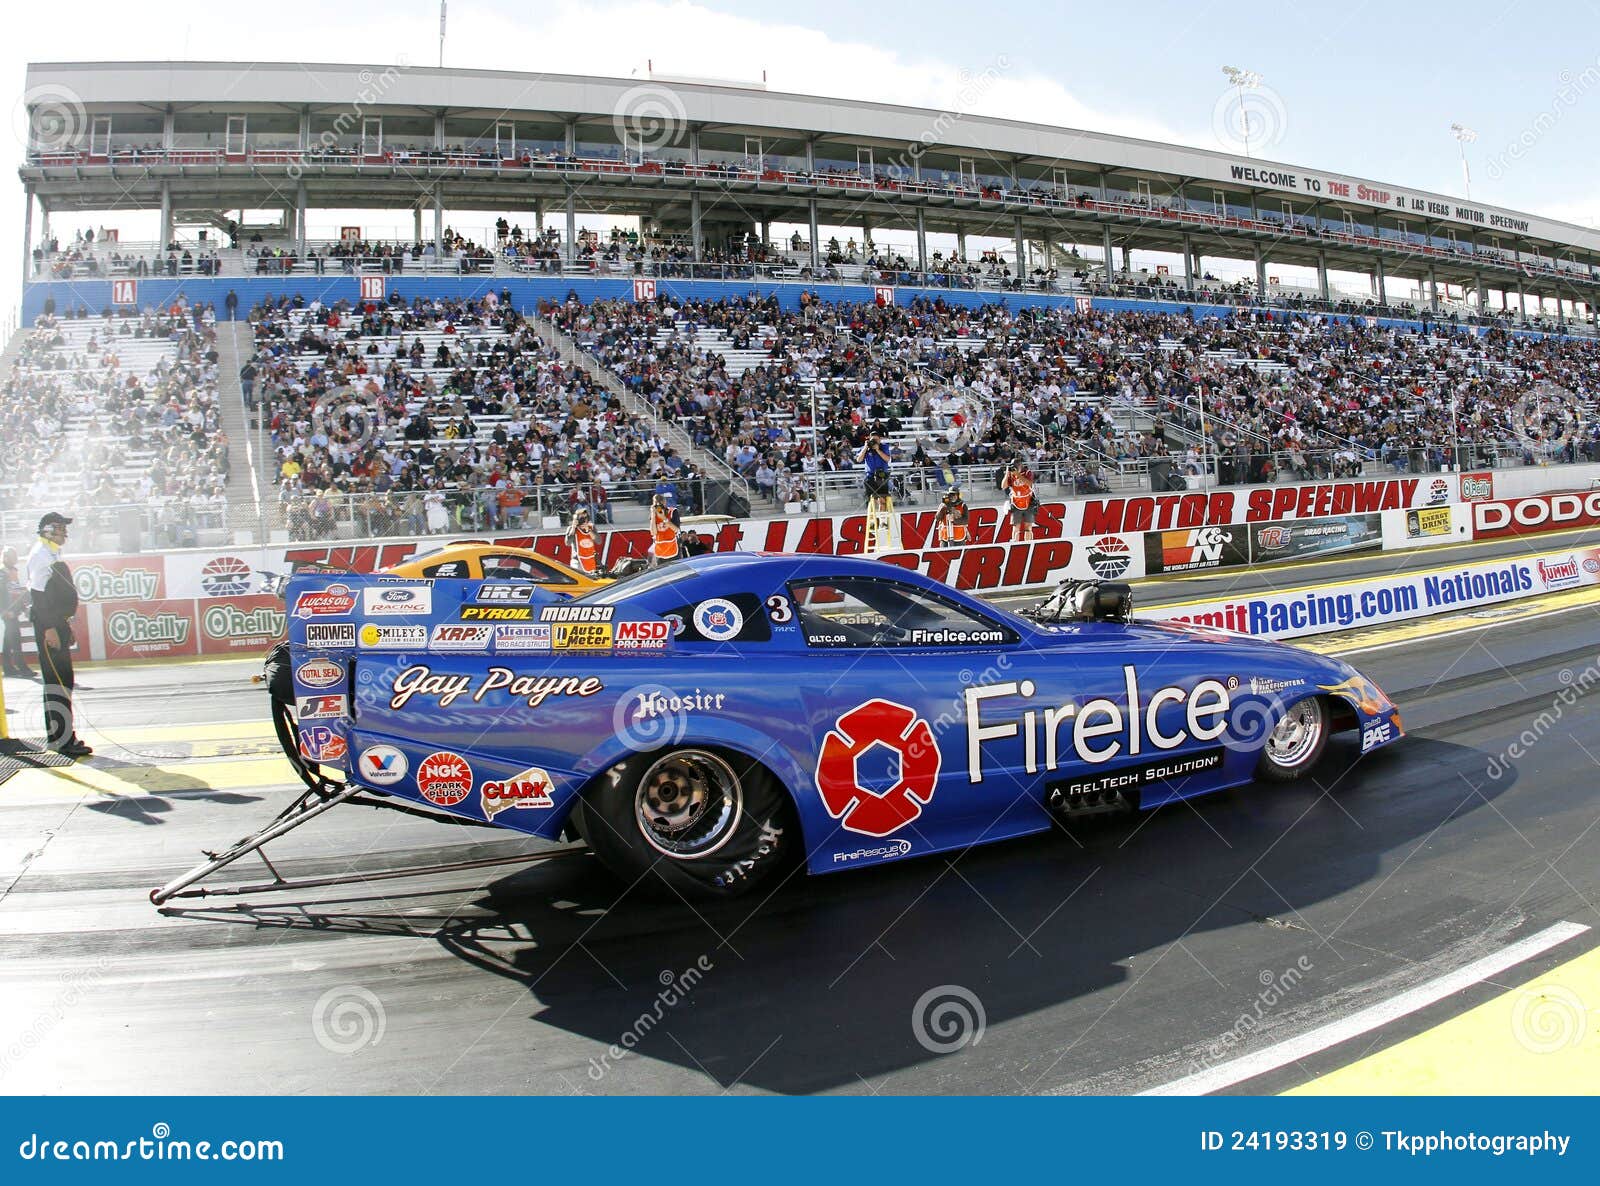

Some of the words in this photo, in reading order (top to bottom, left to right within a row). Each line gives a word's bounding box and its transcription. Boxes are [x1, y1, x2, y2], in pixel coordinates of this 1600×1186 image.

[1230, 165, 1297, 188] WELCOME
[1303, 177, 1321, 192] TO
[1327, 180, 1350, 198] THE
[1357, 183, 1391, 204] STRIP
[1411, 198, 1425, 213] LAS
[1428, 201, 1450, 217] VEGAS
[1455, 207, 1485, 224] MOTOR
[1489, 214, 1530, 233] SPEEDWAY
[114, 282, 135, 302] 1A
[363, 278, 384, 299] 1B
[635, 280, 655, 300] 1C
[1463, 478, 1490, 497] O'Reilly
[763, 514, 875, 554] LAS
[900, 502, 1067, 550] VGAS
[1080, 491, 1235, 537] MOTOR
[1246, 479, 1420, 522] SPEEDWAY
[1422, 519, 1449, 529] DRINK
[1258, 528, 1292, 547] TRE
[1304, 527, 1323, 536] DRAG
[1322, 525, 1347, 535] RACING
[438, 563, 458, 573] 2
[74, 567, 158, 600] O'Reilly
[1424, 563, 1533, 607] Nationals
[302, 596, 334, 607] LUCAS
[334, 596, 350, 606] OIL
[386, 590, 410, 601] Ford
[371, 604, 425, 612] RACING
[461, 608, 533, 620] PYROIL
[540, 606, 615, 621] MOROSO
[766, 595, 793, 624] 3
[109, 611, 190, 643] O'Reilly
[206, 605, 287, 639] O'Reilly
[307, 625, 354, 641] CROWER
[376, 627, 425, 638] SMILEY'S
[435, 627, 479, 641] XRP
[497, 625, 550, 637] Strange
[570, 625, 604, 635] Auto
[619, 622, 667, 639] MSD
[911, 629, 1003, 643] FireIce.com
[526, 640, 550, 648] STRUTS
[568, 635, 610, 646] Meter
[617, 639, 638, 649] PRO
[640, 639, 664, 648] MAG
[301, 669, 323, 679] TOTAL
[322, 668, 340, 678] SEAL
[474, 666, 603, 708] Payne
[1259, 678, 1305, 690] FIREFIGHTERS
[300, 695, 343, 718] JE
[633, 688, 726, 719] Hoosier
[1362, 722, 1391, 751] BAE
[425, 764, 463, 779] NGK
[428, 781, 463, 790] SPARK
[428, 789, 463, 797] PLUGS
[483, 781, 548, 799] CLARK
